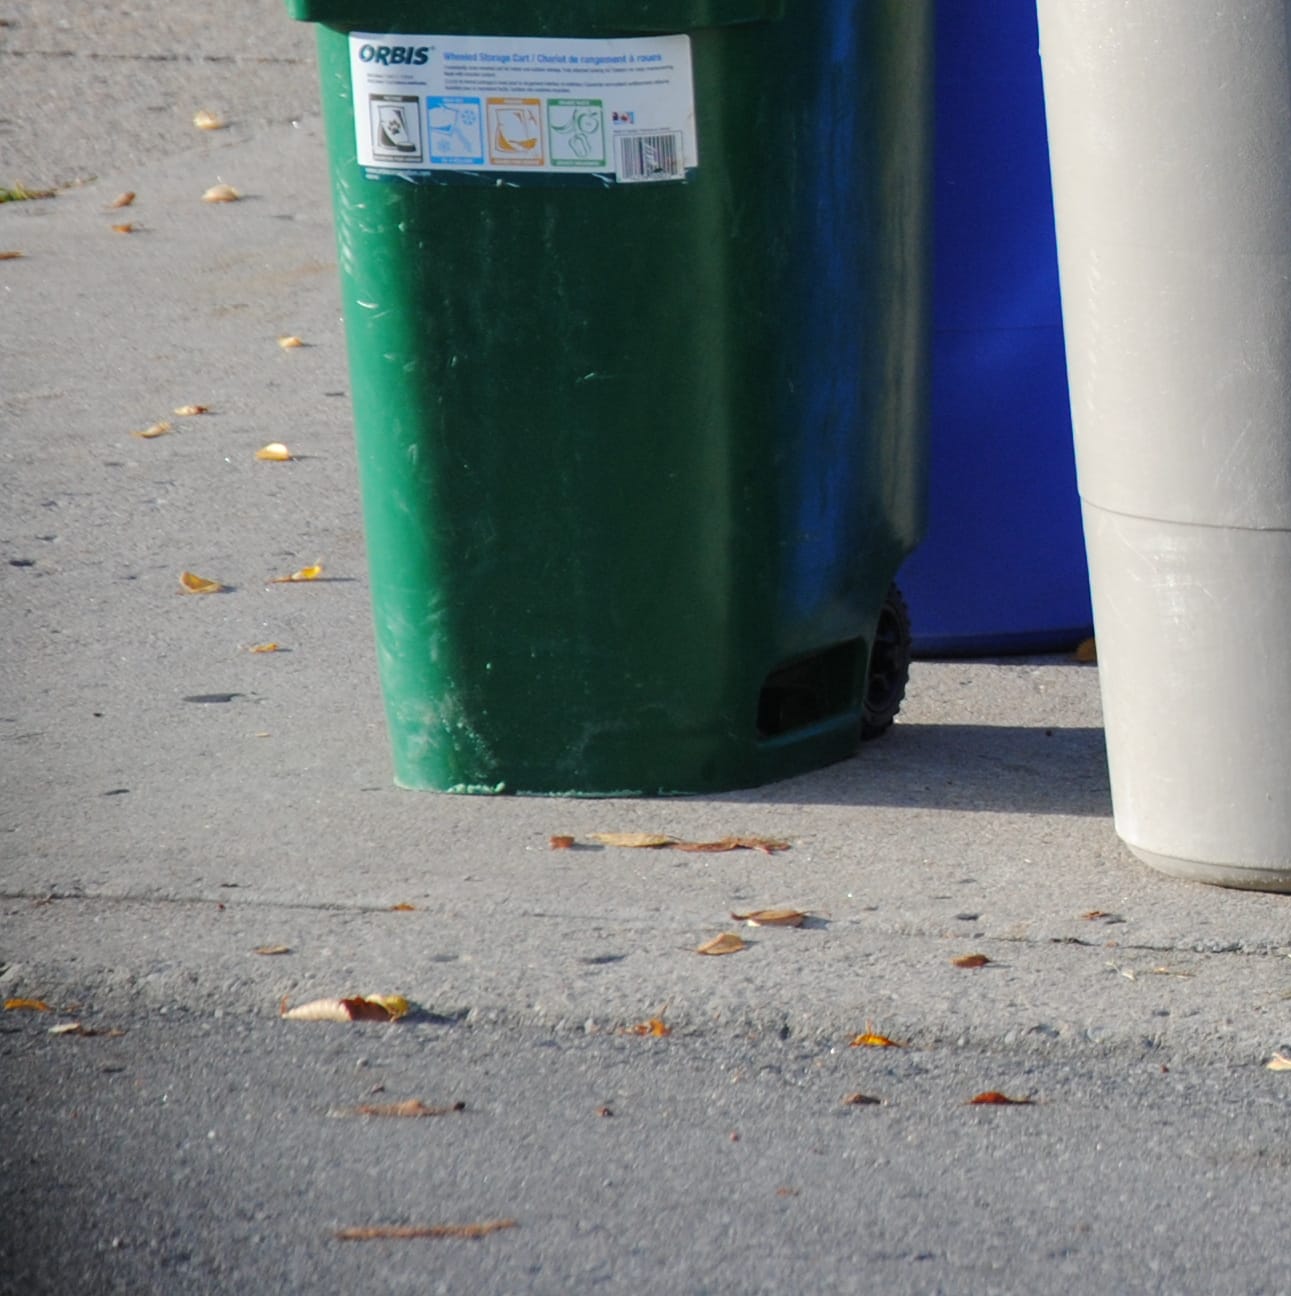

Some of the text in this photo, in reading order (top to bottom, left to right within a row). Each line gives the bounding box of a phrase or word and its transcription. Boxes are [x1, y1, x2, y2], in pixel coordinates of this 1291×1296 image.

[359, 44, 429, 66] ORBIS
[480, 53, 511, 64] Storage
[513, 53, 530, 63] Cart
